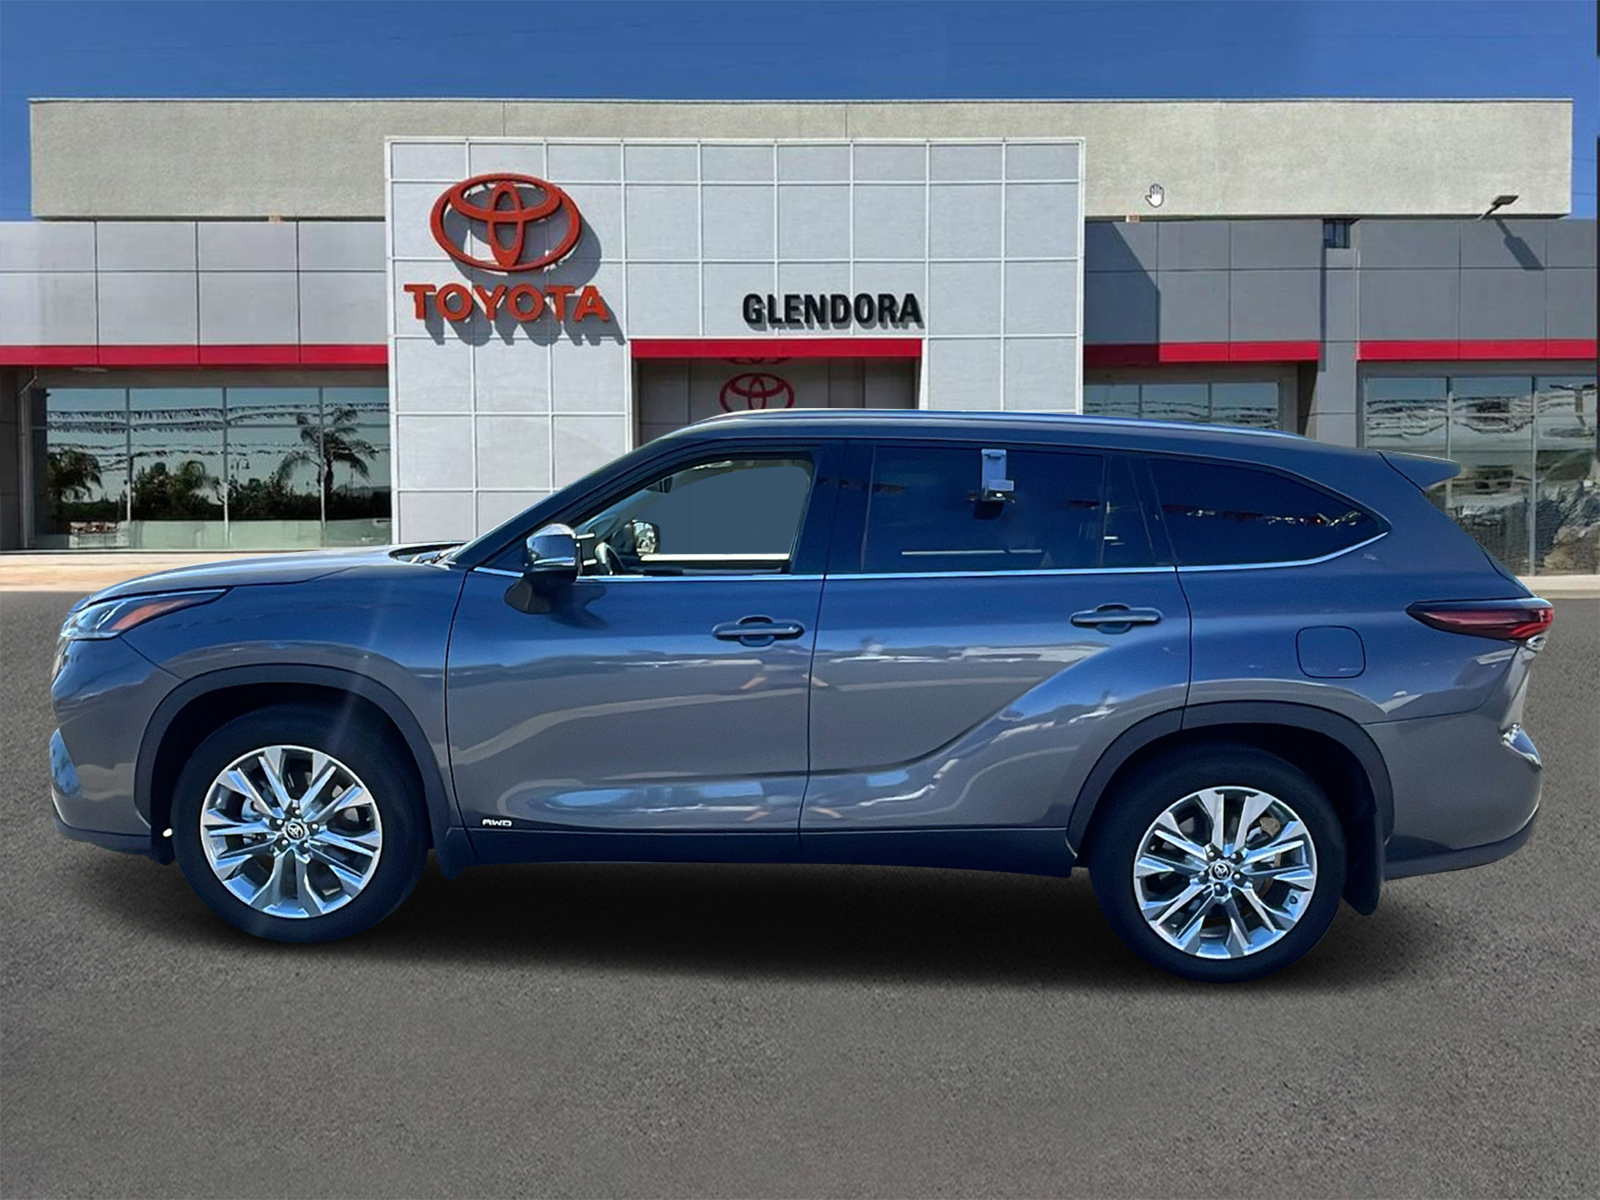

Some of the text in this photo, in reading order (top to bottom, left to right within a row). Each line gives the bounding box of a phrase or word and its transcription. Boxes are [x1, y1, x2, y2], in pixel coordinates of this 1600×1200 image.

[404, 284, 610, 323] TOYOTA
[742, 293, 922, 326] GLENDORA
[482, 818, 513, 827] AWD
